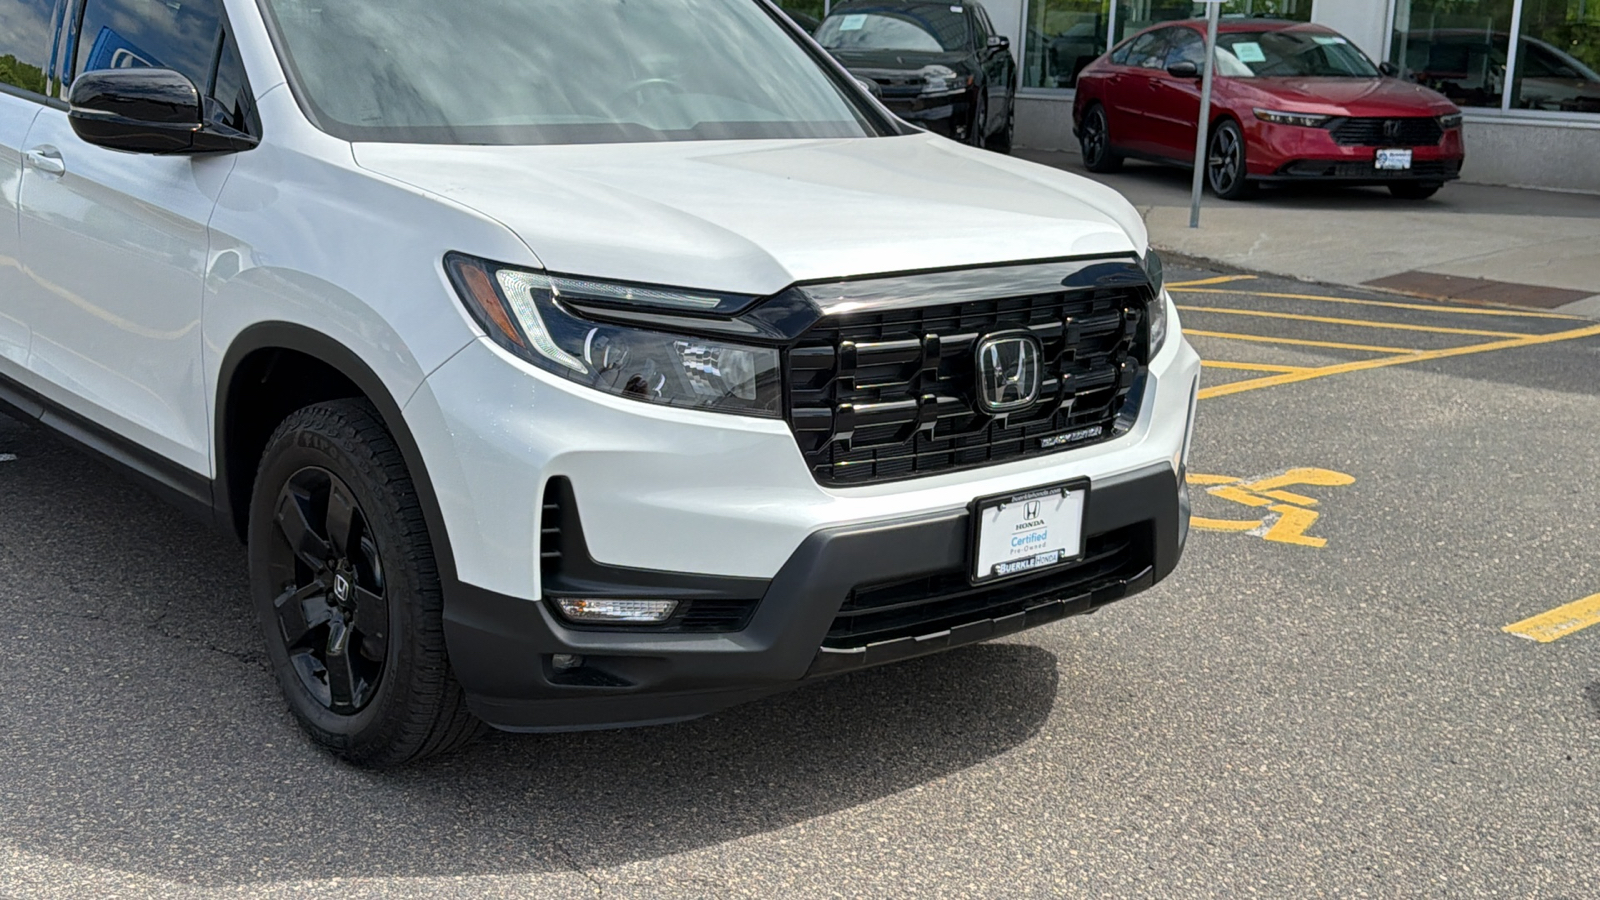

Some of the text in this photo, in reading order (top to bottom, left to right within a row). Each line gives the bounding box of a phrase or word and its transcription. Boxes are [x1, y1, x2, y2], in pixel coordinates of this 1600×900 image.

[1015, 519, 1045, 530] HONDA
[1011, 529, 1047, 547] Certified
[1010, 541, 1046, 555] Pre-Owned
[1036, 554, 1057, 565] HONDA
